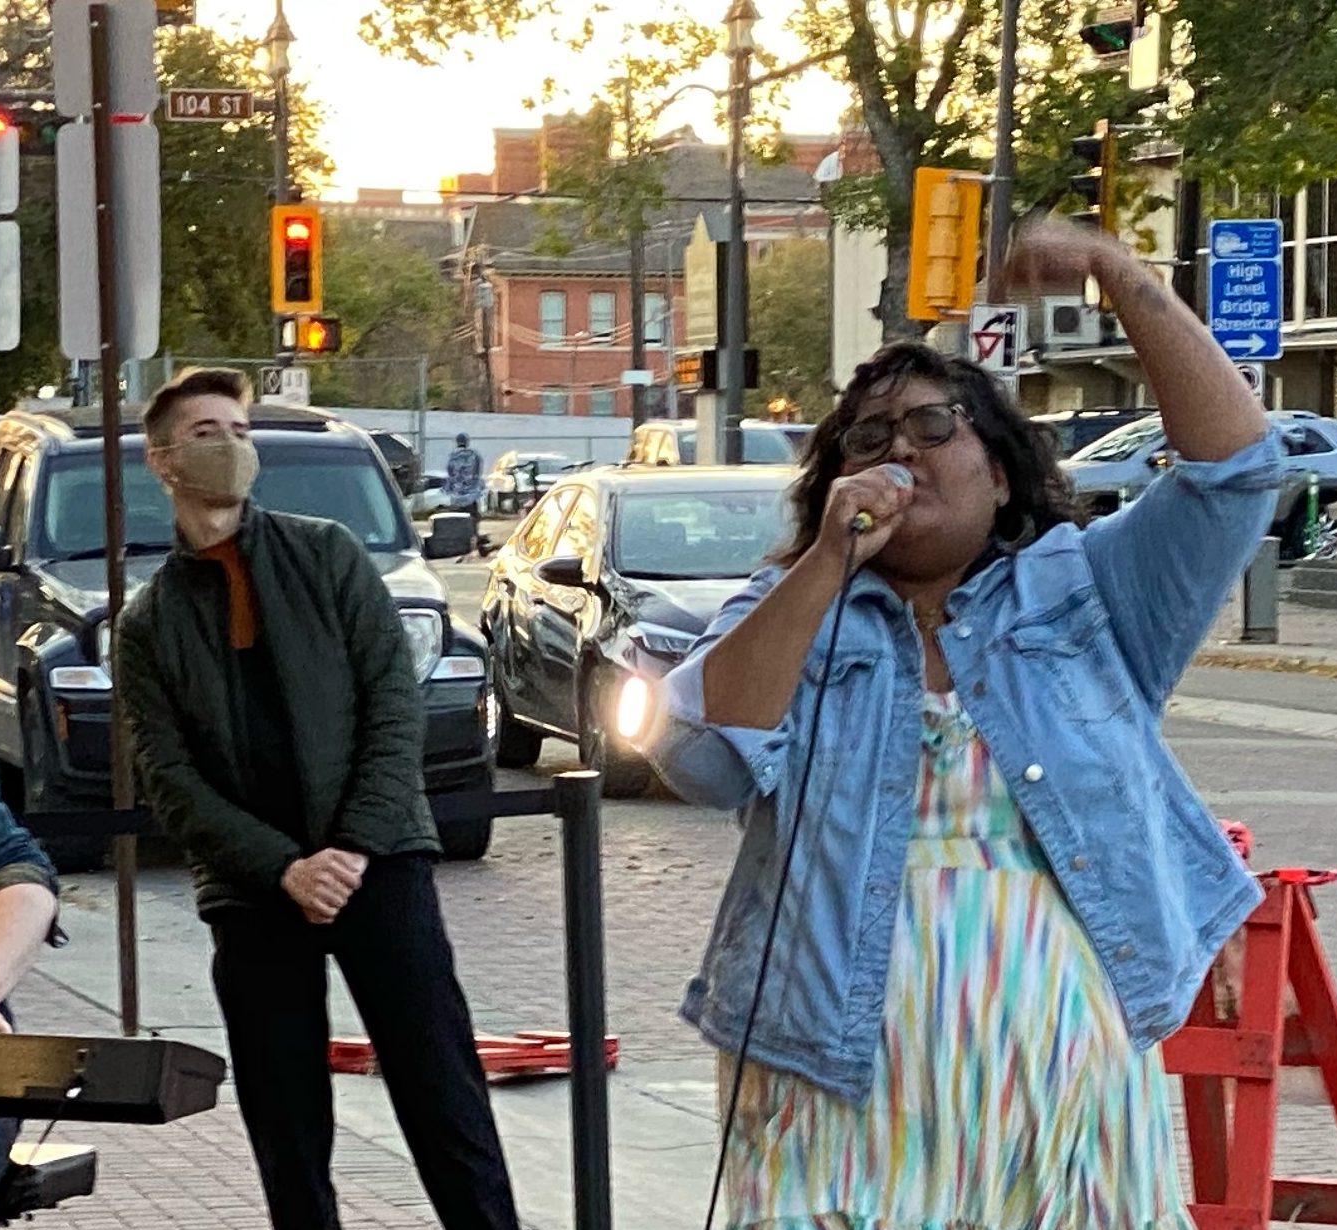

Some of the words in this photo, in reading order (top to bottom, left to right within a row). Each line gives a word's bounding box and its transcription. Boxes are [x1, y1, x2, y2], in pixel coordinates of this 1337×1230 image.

[176, 94, 211, 115] 104
[219, 94, 243, 115] ST
[1227, 263, 1263, 282] High
[1219, 299, 1271, 317] Bridge
